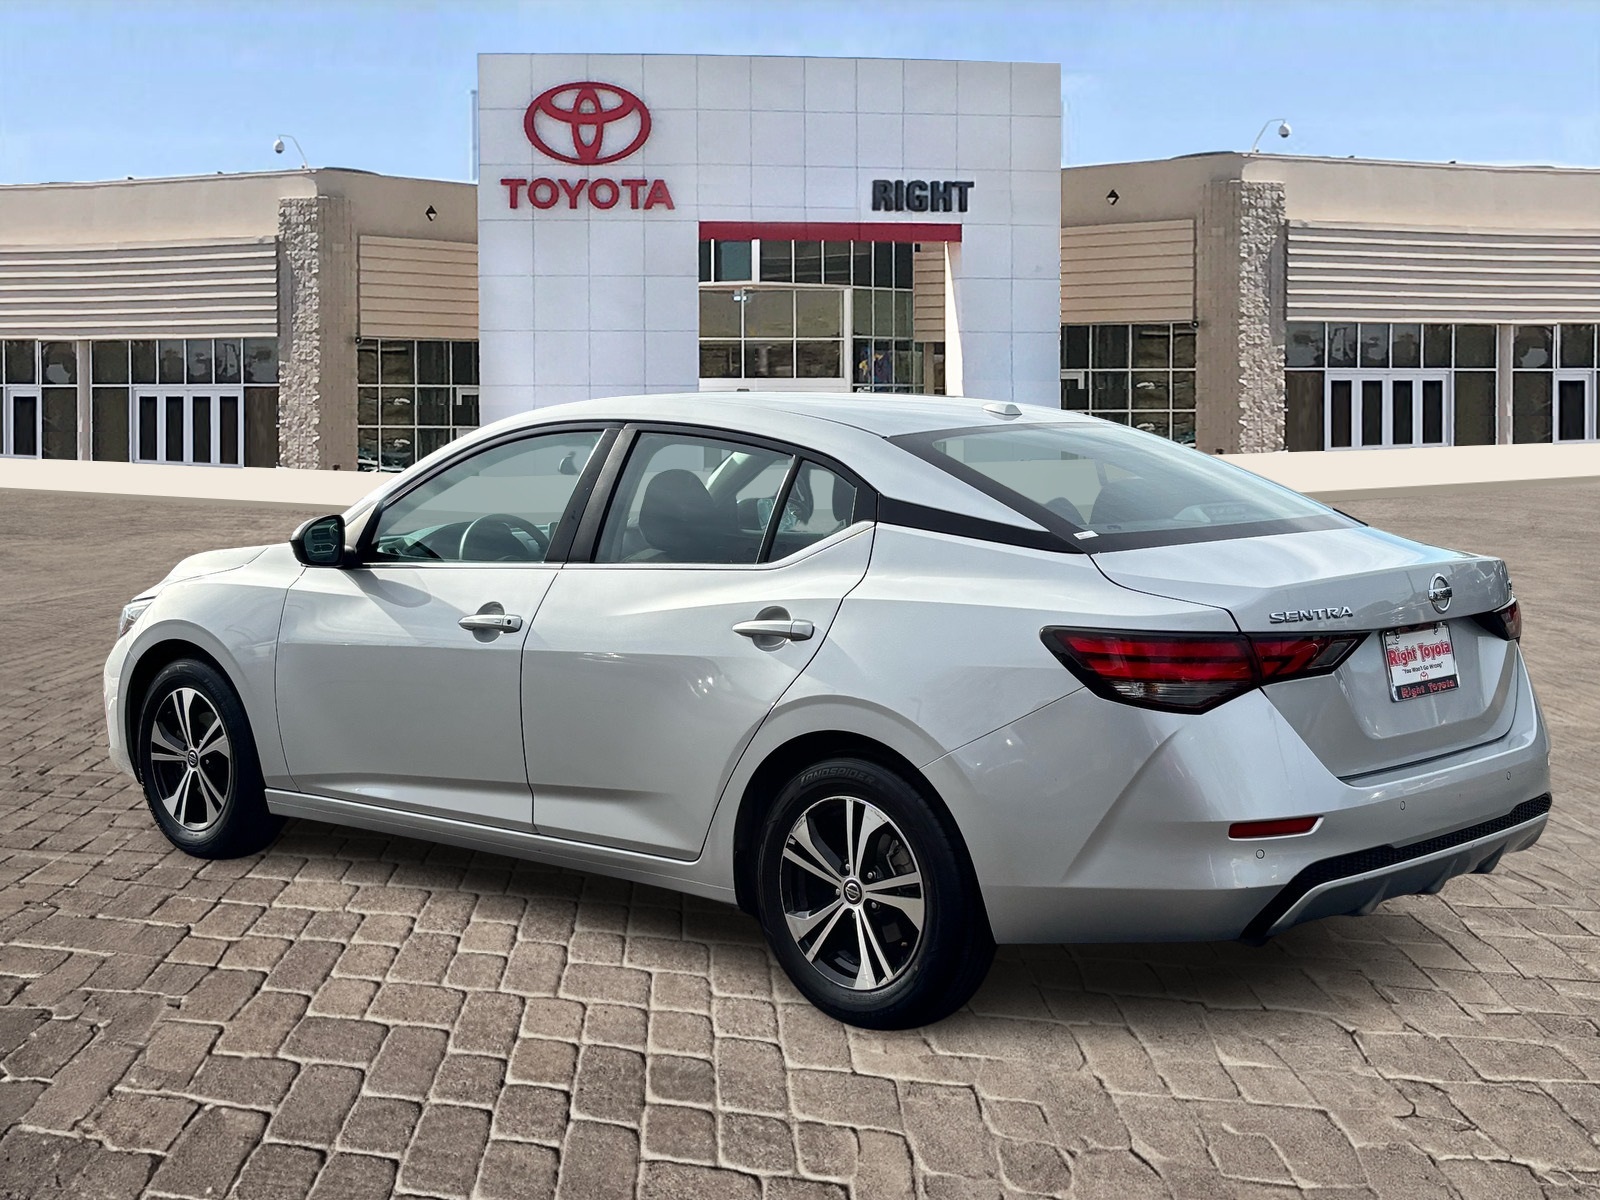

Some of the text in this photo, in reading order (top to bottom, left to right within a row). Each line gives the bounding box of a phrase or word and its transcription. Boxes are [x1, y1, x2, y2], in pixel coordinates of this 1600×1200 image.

[500, 177, 676, 210] TOYOTA
[872, 179, 975, 212] RIGHT
[1269, 606, 1353, 624] SENTRA
[1387, 640, 1452, 667] Right Toyota
[1401, 679, 1455, 698] Right Toyota
